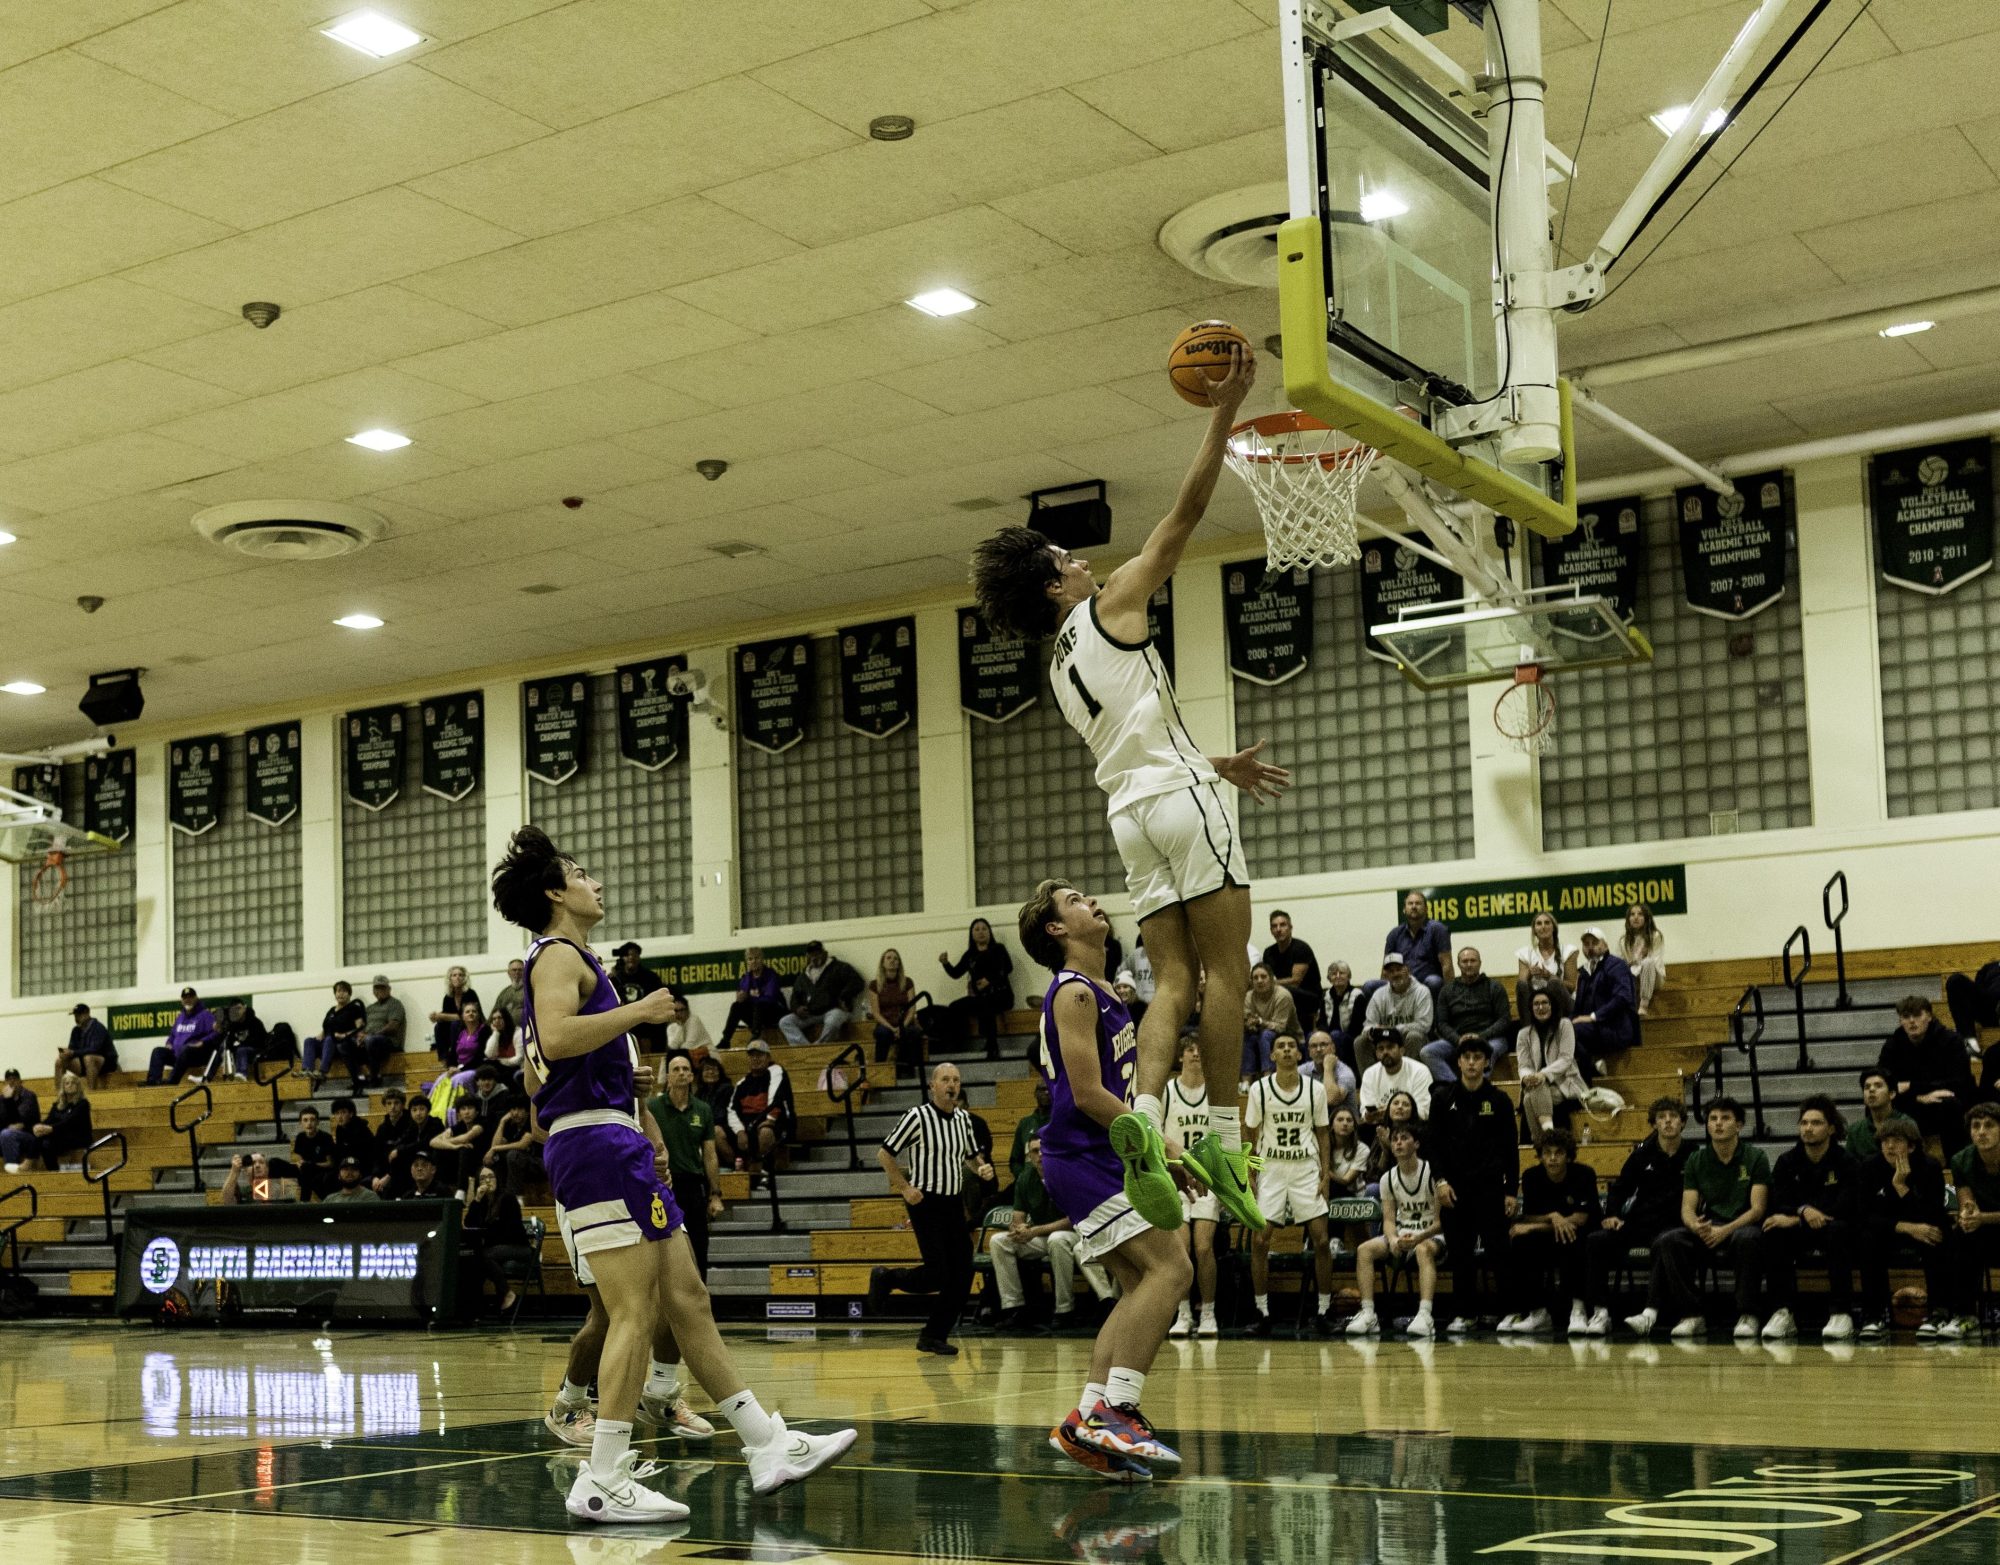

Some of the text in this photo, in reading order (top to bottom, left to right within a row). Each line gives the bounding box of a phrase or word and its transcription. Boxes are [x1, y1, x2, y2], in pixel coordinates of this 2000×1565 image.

[1900, 488, 1969, 509] VOLLEYBALL
[1897, 499, 1975, 522] ACADEMIC TEAM
[1701, 520, 1764, 540] VOLLEYBALL
[1909, 516, 1964, 535] CHAMPIONS
[1699, 531, 1771, 554] ACADEMIC TEAM
[1564, 545, 1618, 562] SWIMMING
[1710, 546, 1761, 566] CHAMPIONS
[1909, 549, 1934, 564] 2010
[1942, 544, 1967, 560] 2011
[1558, 556, 1627, 576] ACADEMIC TEAM
[1380, 573, 1435, 591] VOLLEYBALL
[1569, 571, 1618, 588] CHAMPIONS
[1711, 578, 1733, 594] 2007
[1742, 572, 1765, 589] 2008
[1377, 583, 1441, 603] ACADEMIC TEAM
[1240, 606, 1301, 624] ACADEMIC TEAM
[1249, 620, 1293, 636] CHAMPIONS
[1274, 643, 1294, 658] 2007
[1068, 664, 1103, 719] 1
[1465, 889, 1553, 918] GENERAL
[1559, 879, 1675, 911] ADMISSION
[681, 962, 735, 984] GENERAL
[112, 1012, 154, 1031] VISITING
[1178, 1114, 1210, 1127] SANTA
[1272, 1111, 1305, 1124] SANTA
[1183, 1131, 1204, 1151] 12
[1277, 1128, 1301, 1147] 22
[1329, 1202, 1375, 1219] DONS
[188, 1242, 417, 1281] SANTA BARBARA DONS
[1472, 1464, 1976, 1565] DONS
